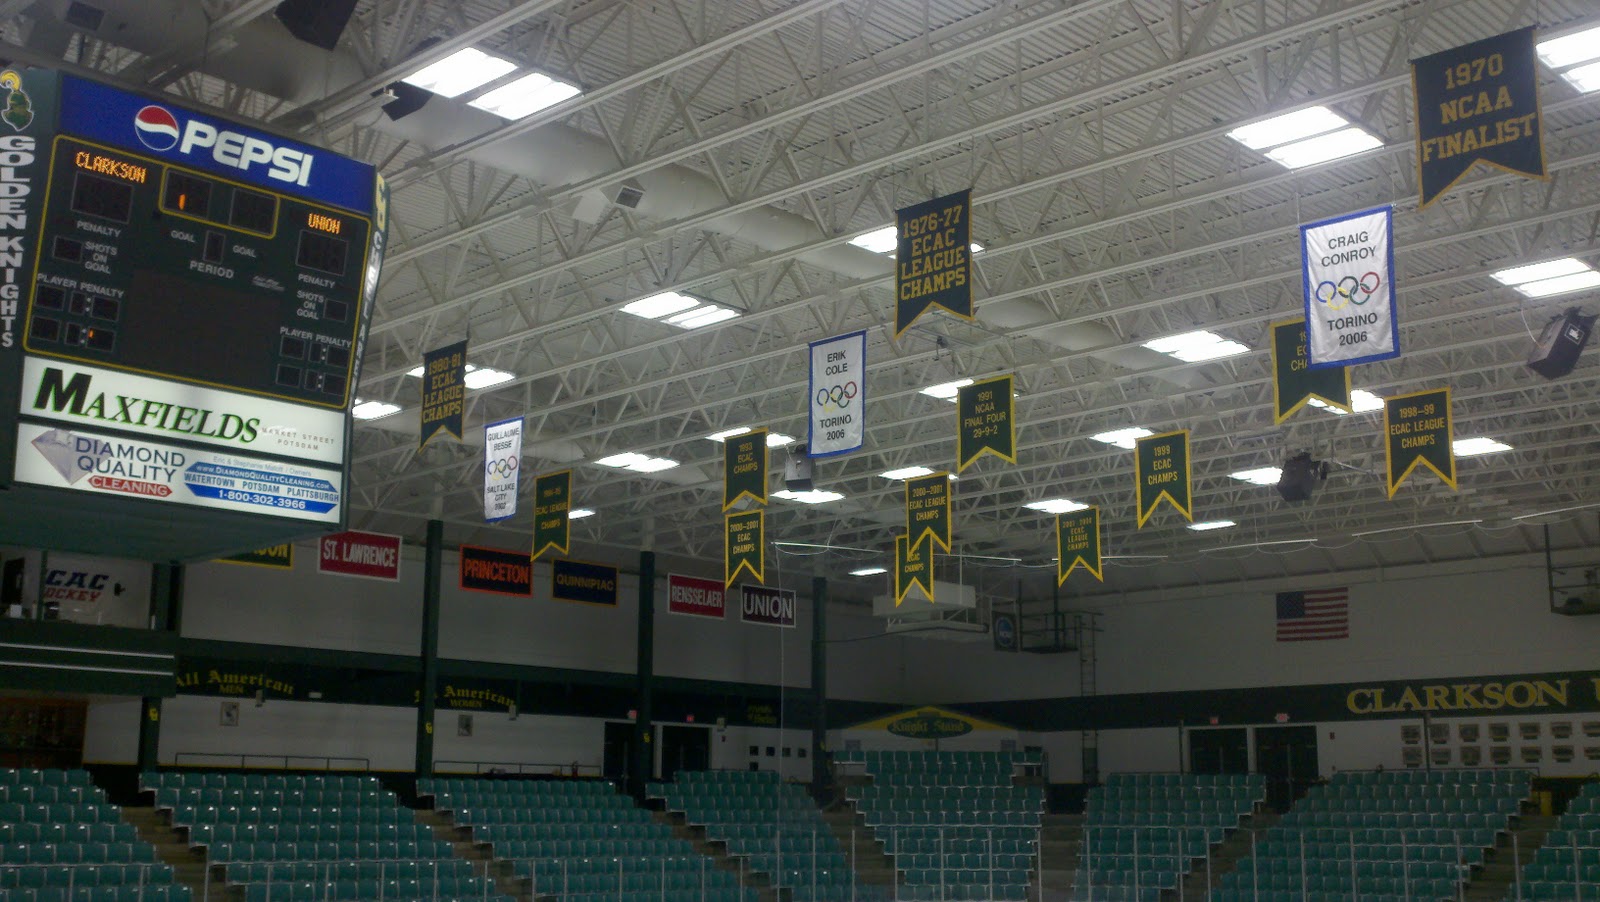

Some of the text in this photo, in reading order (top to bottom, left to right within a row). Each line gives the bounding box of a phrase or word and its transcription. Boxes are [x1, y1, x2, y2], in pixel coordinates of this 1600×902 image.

[1445, 53, 1503, 89] 1970
[1440, 85, 1513, 124] NCAA
[1422, 112, 1536, 163] FINALIST
[180, 119, 314, 187] PEPSI
[75, 151, 146, 184] CLARKSON
[0, 135, 36, 230] GOLDEN
[76, 220, 121, 238] PENALTY
[307, 213, 341, 235] UNION
[903, 205, 962, 239] 1976-77
[170, 230, 195, 243] GOAL
[911, 228, 956, 257] ECAC
[1328, 231, 1369, 250] CRAIG
[84, 241, 118, 256] SHOTS
[232, 245, 256, 258] GOAL
[1321, 246, 1377, 267] CONROY
[93, 253, 107, 263] ON
[901, 245, 965, 280] LEAGUE
[84, 261, 111, 274] GOAL
[189, 260, 234, 279] PERIOD
[37, 273, 125, 298] PLAYER PENALTY
[298, 273, 336, 289] PENALTY
[900, 267, 966, 301] CHAMPS
[0, 236, 25, 347] KNIGHTS
[296, 290, 324, 303] SHOTS
[296, 309, 319, 320] GOAL
[303, 301, 315, 310] ON
[1327, 313, 1378, 331] TORINO
[280, 326, 352, 347] PLAYER PENALTY
[1339, 332, 1368, 346] 2006
[429, 353, 461, 376] 1980-81
[827, 350, 846, 363] ERIK
[825, 363, 848, 376] COLE
[432, 371, 456, 389] ECAC
[33, 367, 260, 443] MAXFIELDS
[424, 385, 462, 407] LEAGUE
[977, 391, 993, 401] 1991
[423, 400, 461, 424] CHAMPS
[975, 402, 995, 414] NCAA
[1399, 404, 1435, 417] 1998-99
[820, 414, 852, 429] TORINO
[964, 412, 1006, 428] FINAL FOUR
[1391, 417, 1445, 435] ECAC LEAGUE
[302, 434, 334, 444] STREET
[488, 428, 520, 441] GUILLAUME
[826, 429, 845, 441] 2006
[973, 425, 998, 438] 29-9-2
[277, 439, 319, 450] POTSDAM
[494, 440, 512, 451] BESSE
[1401, 434, 1435, 449] CHAMPS
[75, 437, 186, 467] DIAMOND
[737, 452, 753, 462] ECAC
[1153, 445, 1170, 457] 1999
[77, 456, 177, 483] QUALITY
[734, 462, 758, 474] CHAMPS
[1153, 458, 1172, 470] ECAC
[91, 476, 168, 496] CLEANING
[184, 472, 339, 503] WATERTOWN POTSDAM PLATTSBURGH
[1148, 471, 1178, 486] CHAMPS
[487, 483, 515, 494] SALT LAKE
[218, 489, 306, 510] 1-800-302-3966
[909, 496, 946, 509] ECAC LEAGUE
[916, 511, 939, 522] CHAMPS
[737, 533, 751, 542] ECAC
[324, 538, 395, 568] ST. LAWRENCE
[732, 543, 755, 555] CHAMPS
[464, 559, 528, 584] PRINCETON
[557, 574, 614, 592] QUINNIPIAC
[672, 585, 723, 609] RENSSELAER
[743, 593, 793, 619] UNION
[208, 670, 294, 695] American
[219, 684, 244, 694] MEN
[1347, 679, 1570, 714] CLARKSON
